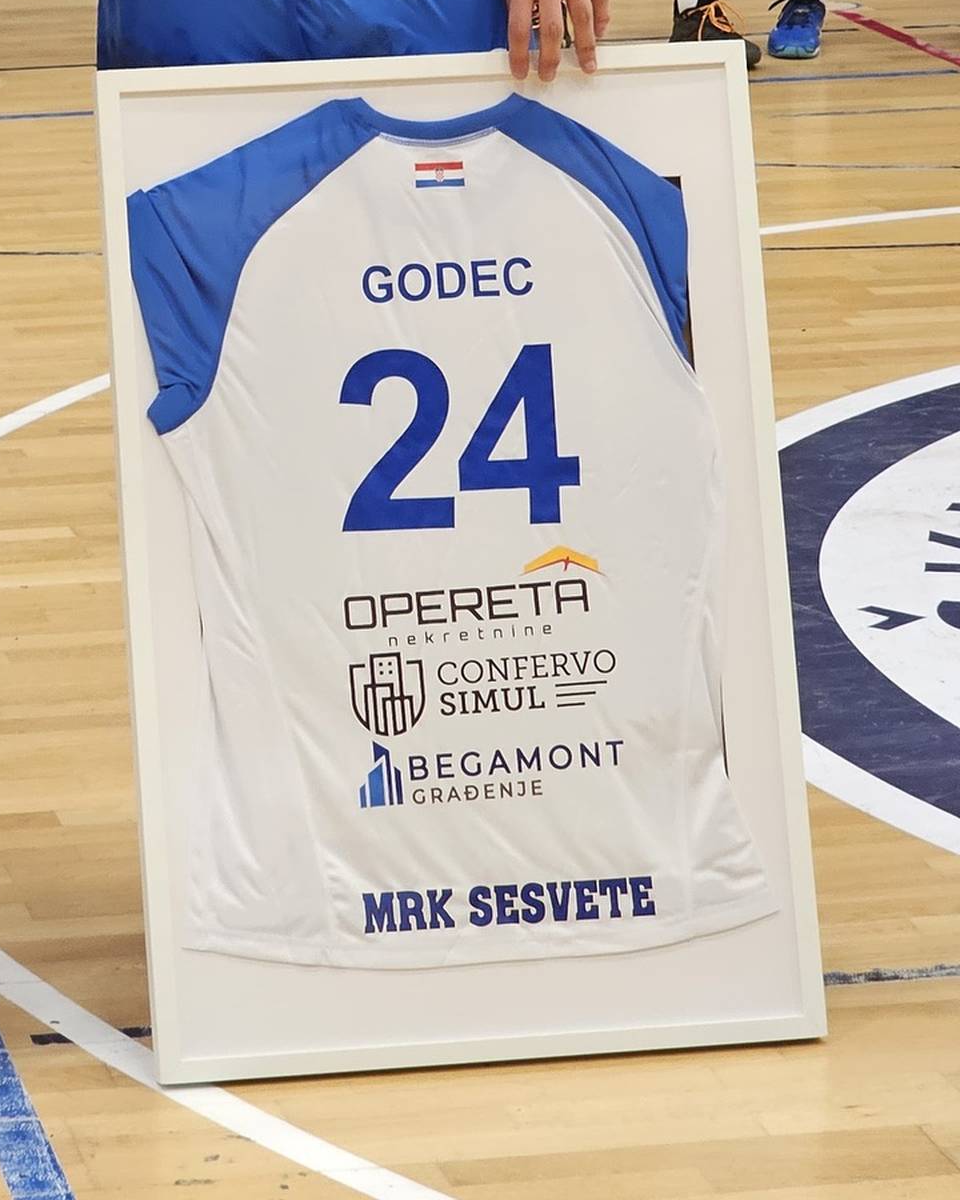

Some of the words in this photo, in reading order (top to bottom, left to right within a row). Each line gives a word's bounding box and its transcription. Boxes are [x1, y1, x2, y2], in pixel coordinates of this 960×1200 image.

[361, 257, 534, 304] GODEC
[339, 343, 581, 532] 24
[344, 578, 590, 631] OPERETA
[388, 624, 553, 648] nekretnine
[436, 649, 617, 686] CONFERVO
[440, 686, 546, 717] SIMUL
[408, 740, 625, 781] BEGAMONT
[412, 779, 544, 805] GRAĐENJE
[362, 887, 456, 934] MRK
[468, 875, 657, 929] SESVETE
